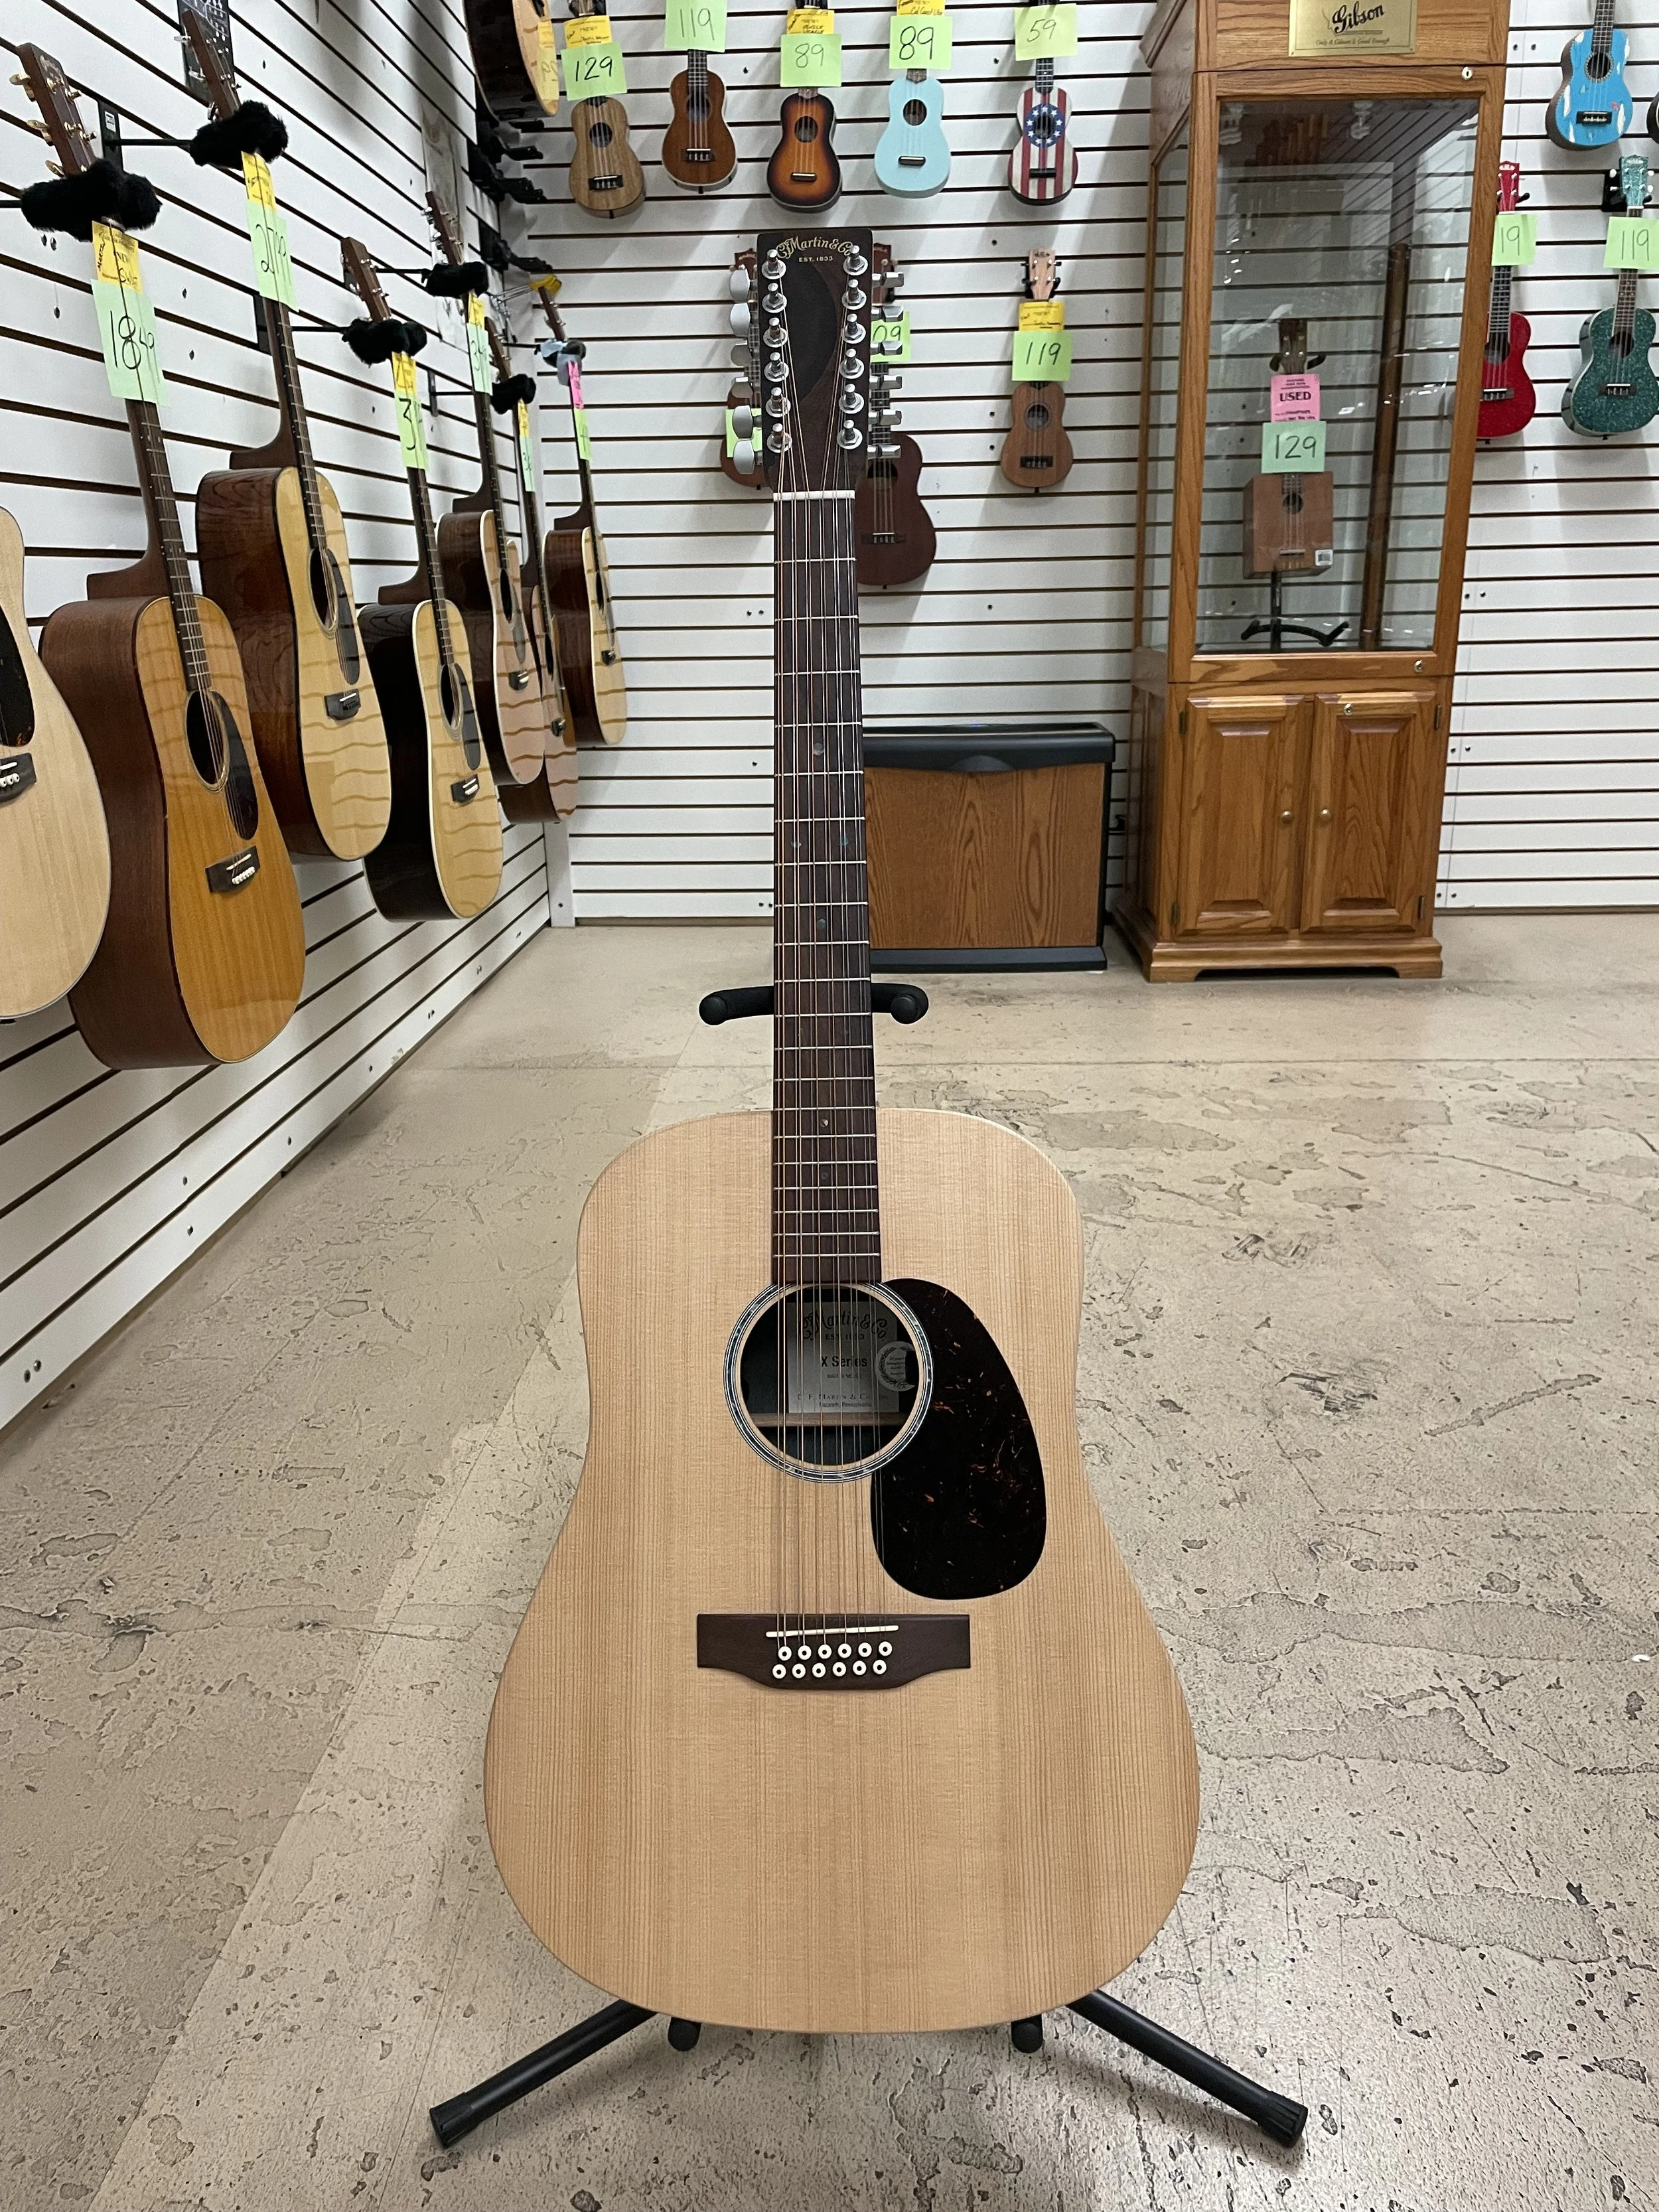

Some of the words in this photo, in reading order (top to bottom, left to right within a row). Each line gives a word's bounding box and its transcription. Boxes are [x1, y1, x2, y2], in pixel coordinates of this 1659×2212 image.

[680, 8, 715, 40] 119
[1332, 1, 1385, 34] Gibson
[899, 26, 934, 60] 89
[1027, 19, 1057, 42] 59
[795, 43, 824, 68] 89
[575, 56, 613, 82] 129
[1621, 228, 1650, 261] 119
[1026, 342, 1061, 365] 119
[1279, 391, 1312, 402] USED
[1275, 435, 1317, 459] 129
[821, 1356, 828, 1367] X
[831, 1355, 868, 1367] Series
